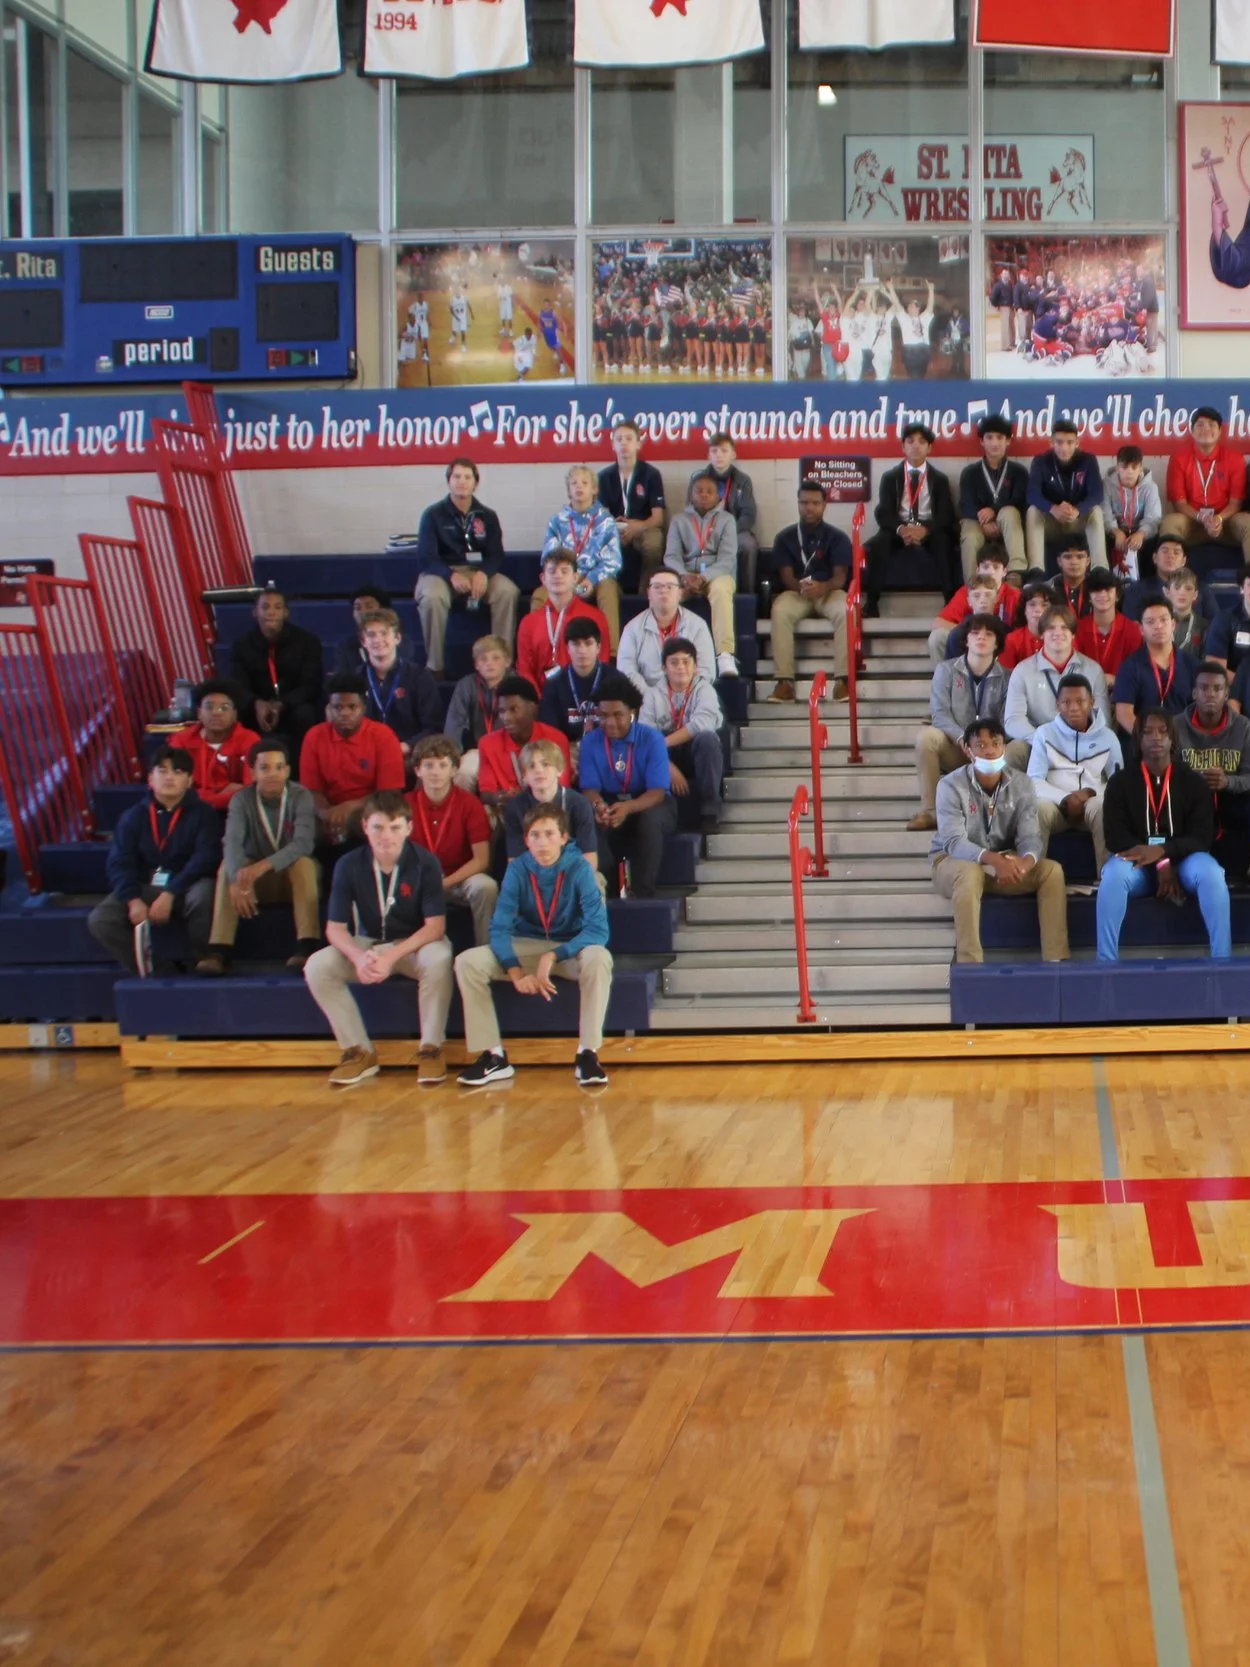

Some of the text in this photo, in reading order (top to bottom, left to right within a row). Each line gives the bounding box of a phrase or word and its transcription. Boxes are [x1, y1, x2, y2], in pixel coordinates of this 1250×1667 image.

[374, 12, 418, 31] 1994
[916, 143, 951, 180] ST.
[901, 186, 1043, 222] WRESLING
[16, 252, 57, 279] Rita
[259, 246, 335, 274] Guests
[124, 336, 195, 367] period
[8, 413, 71, 457] And
[76, 409, 145, 456] we'll
[222, 408, 280, 459] just
[286, 413, 314, 450] to
[321, 405, 371, 450] her
[378, 403, 467, 448] honor
[493, 405, 547, 446] For
[632, 410, 697, 442] ever
[702, 396, 822, 441] staunch
[828, 395, 889, 440] and
[894, 401, 957, 439] true
[1062, 393, 1132, 438] we'll
[1138, 393, 1201, 438] che
[814, 460, 856, 470] No Sitting
[821, 470, 862, 479] Bleachers
[833, 480, 863, 488] Closed
